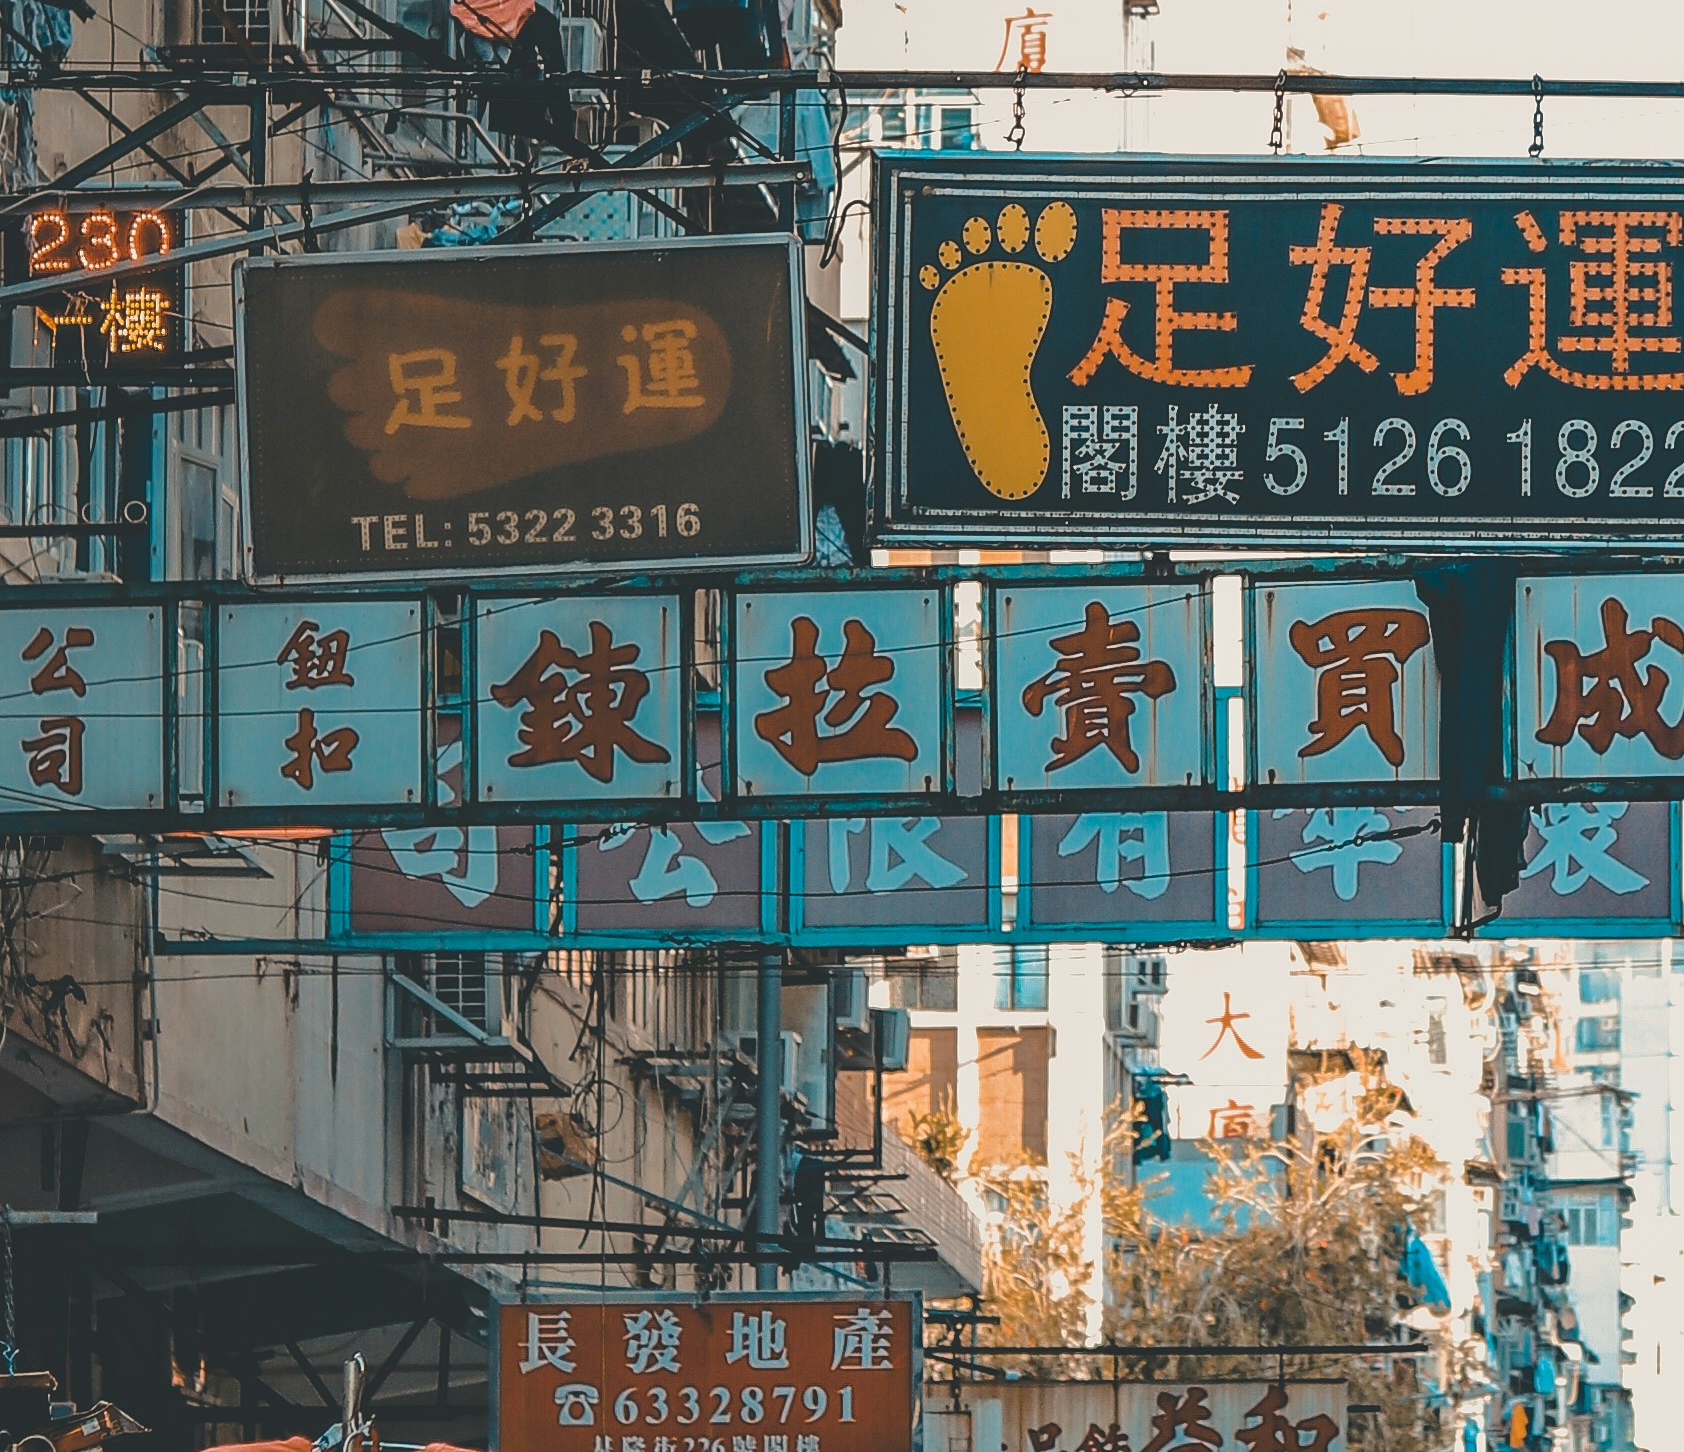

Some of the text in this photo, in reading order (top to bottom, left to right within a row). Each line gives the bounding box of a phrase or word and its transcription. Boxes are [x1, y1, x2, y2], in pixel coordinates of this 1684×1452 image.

[31, 211, 171, 271] 230
[385, 318, 706, 435] 足好運
[1263, 416, 1471, 498] 5126
[350, 502, 702, 551] TEL: 5322 3316
[518, 1307, 894, 1375] 長發地產
[614, 1385, 857, 1425] 63328791
